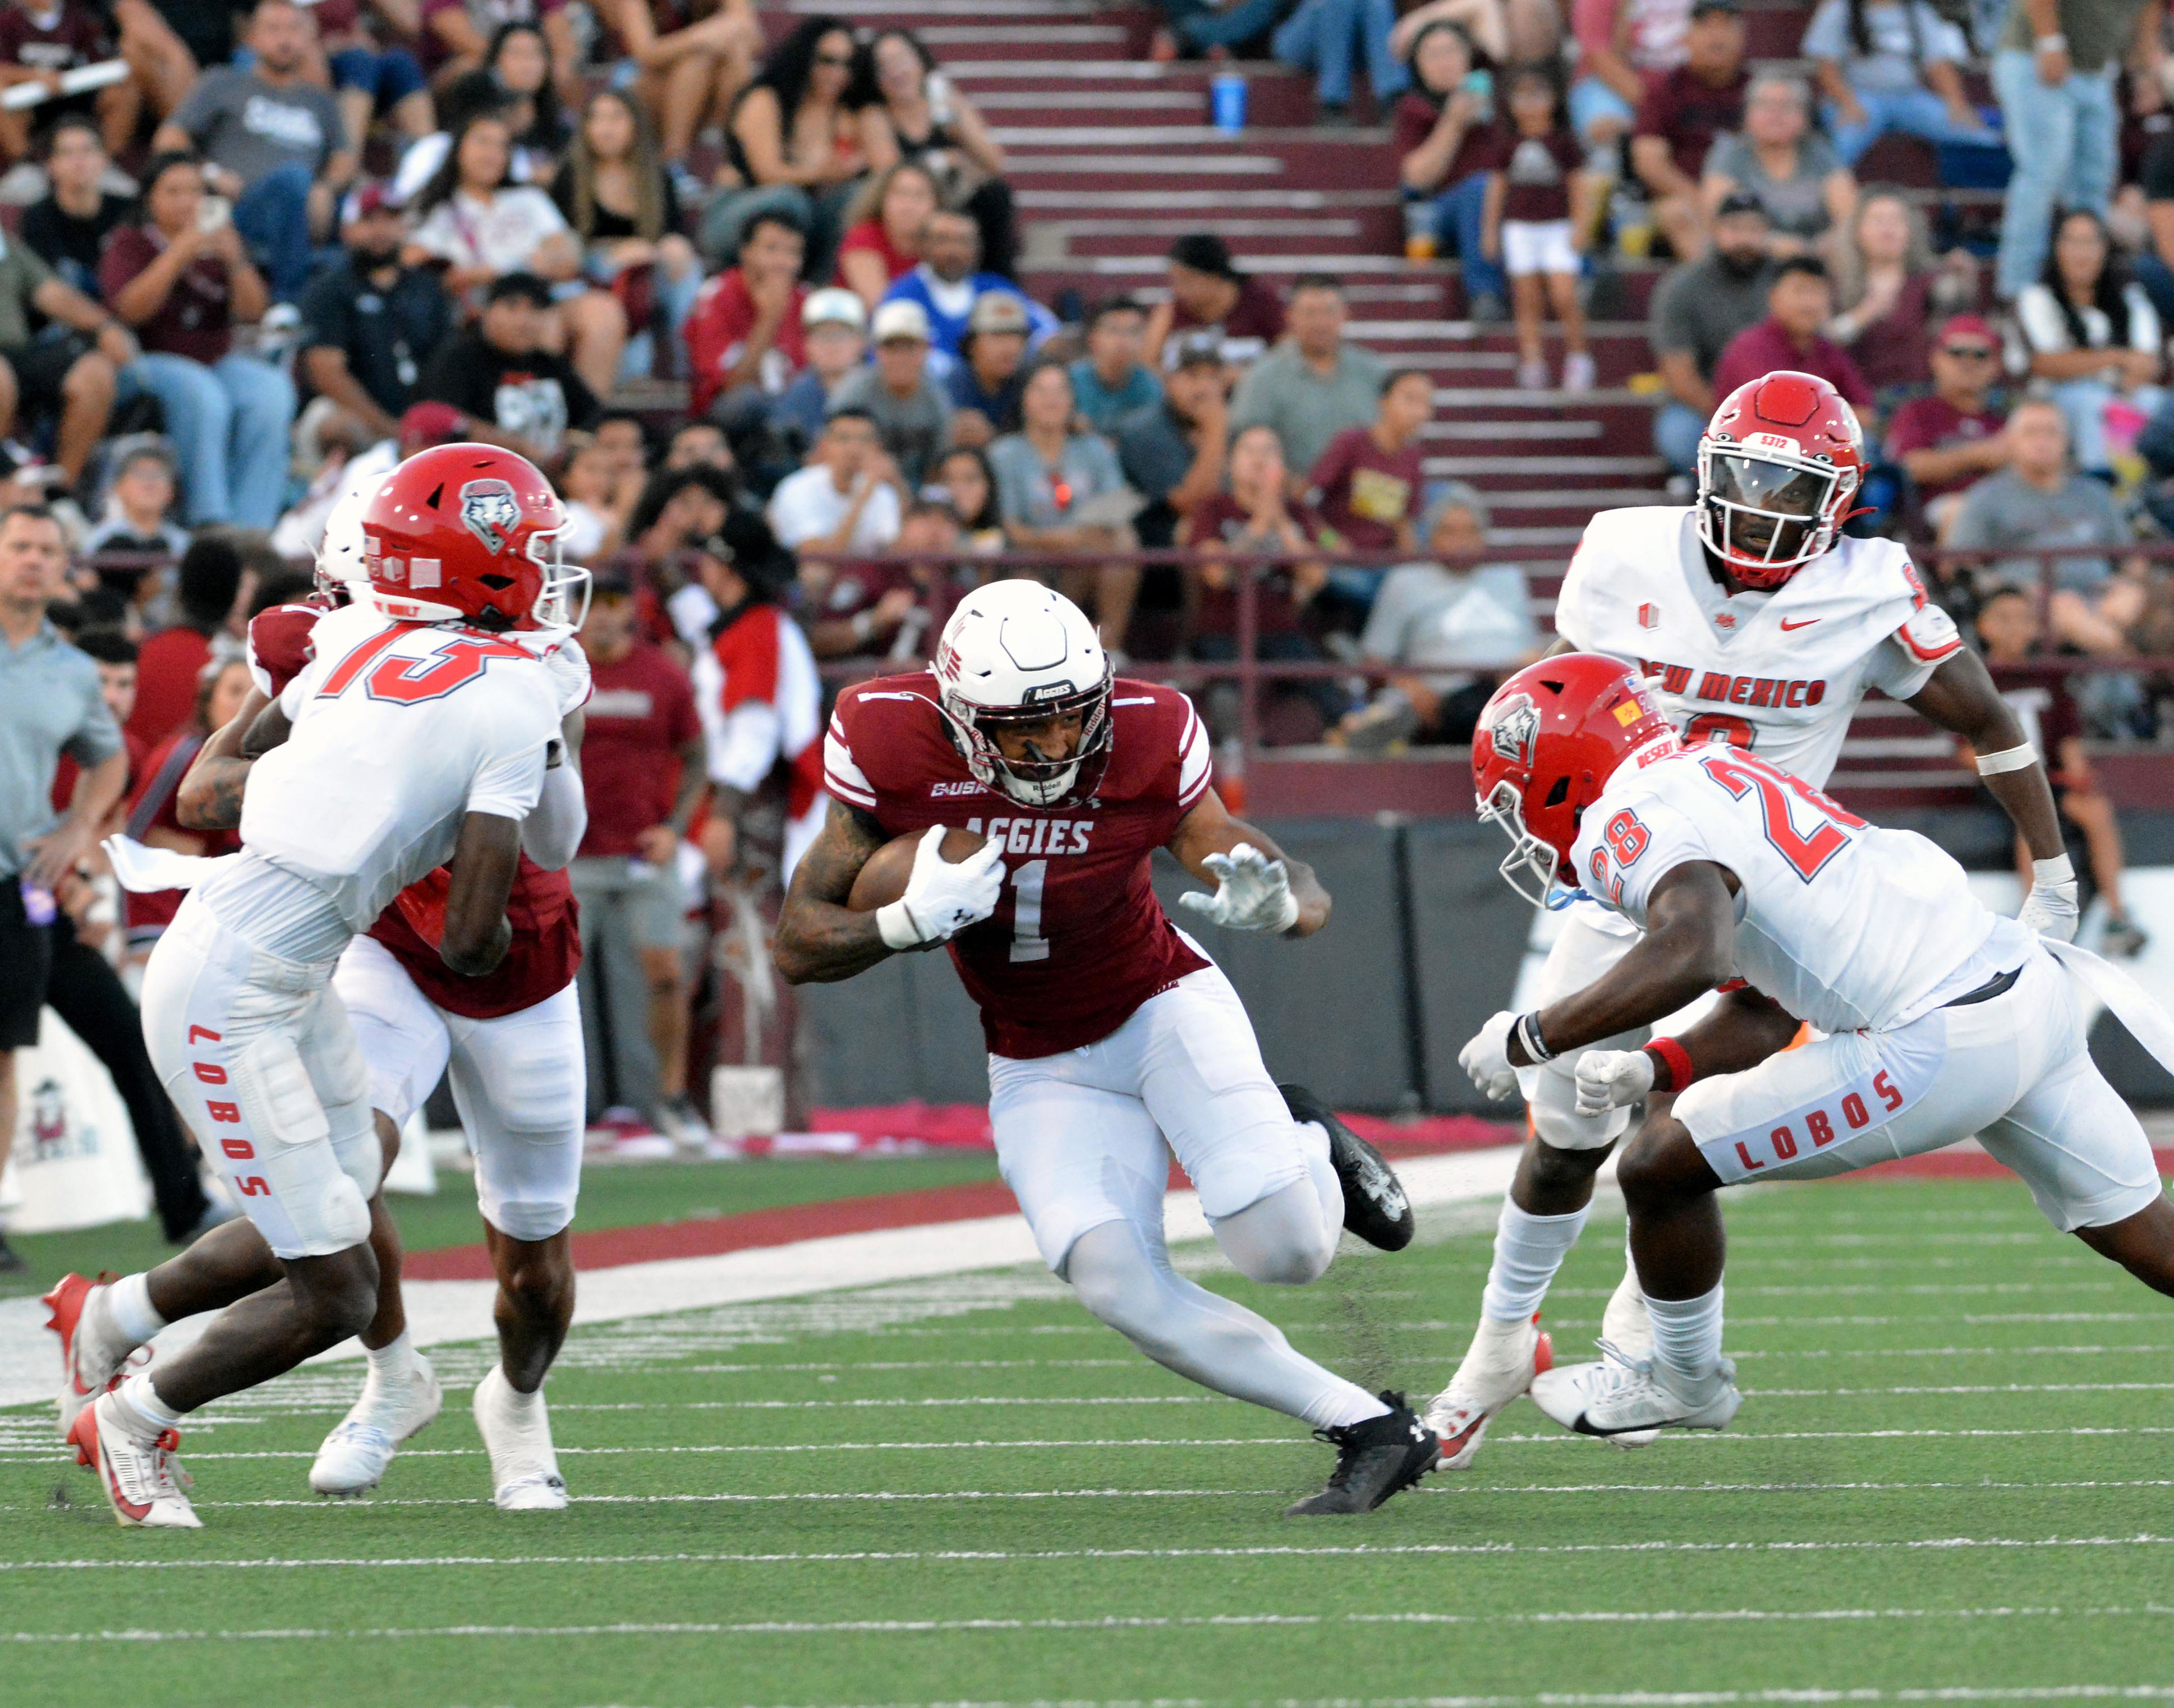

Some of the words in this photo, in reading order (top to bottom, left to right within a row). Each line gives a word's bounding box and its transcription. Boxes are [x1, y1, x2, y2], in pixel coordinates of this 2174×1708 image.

[1761, 435, 1787, 449] 5312
[1697, 671, 1827, 708] MEXICO
[1033, 780, 1061, 791] Rddell
[1589, 807, 1652, 908] 28
[1009, 859, 1050, 963] 1
[189, 1024, 272, 1196] LOBOS
[1735, 1069, 1903, 1170] LOBOS
